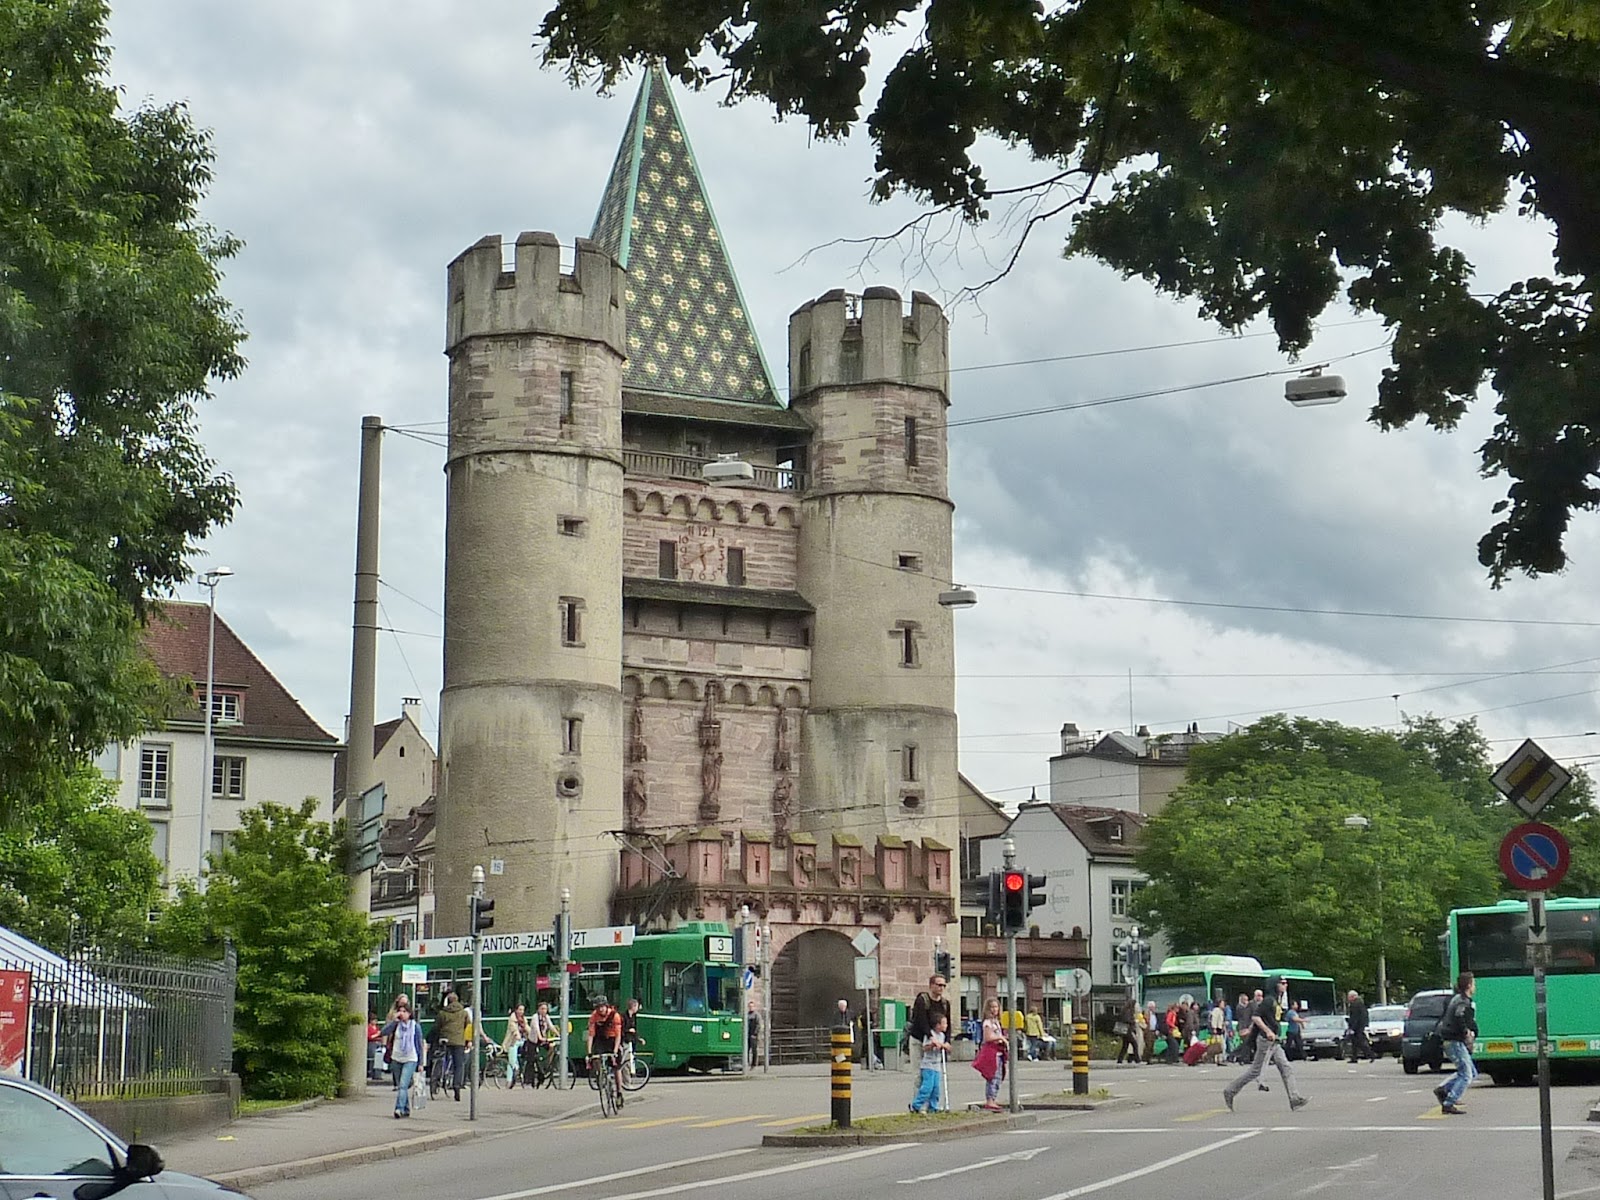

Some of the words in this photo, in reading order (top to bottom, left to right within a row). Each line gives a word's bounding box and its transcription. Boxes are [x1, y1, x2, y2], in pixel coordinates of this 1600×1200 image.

[698, 526, 708, 537] 12
[678, 534, 689, 544] 10
[680, 546, 687, 554] 9
[719, 550, 725, 561] 3
[717, 563, 726, 574] 4
[699, 570, 706, 581] 6
[710, 570, 717, 581] 5
[718, 939, 725, 951] 3
